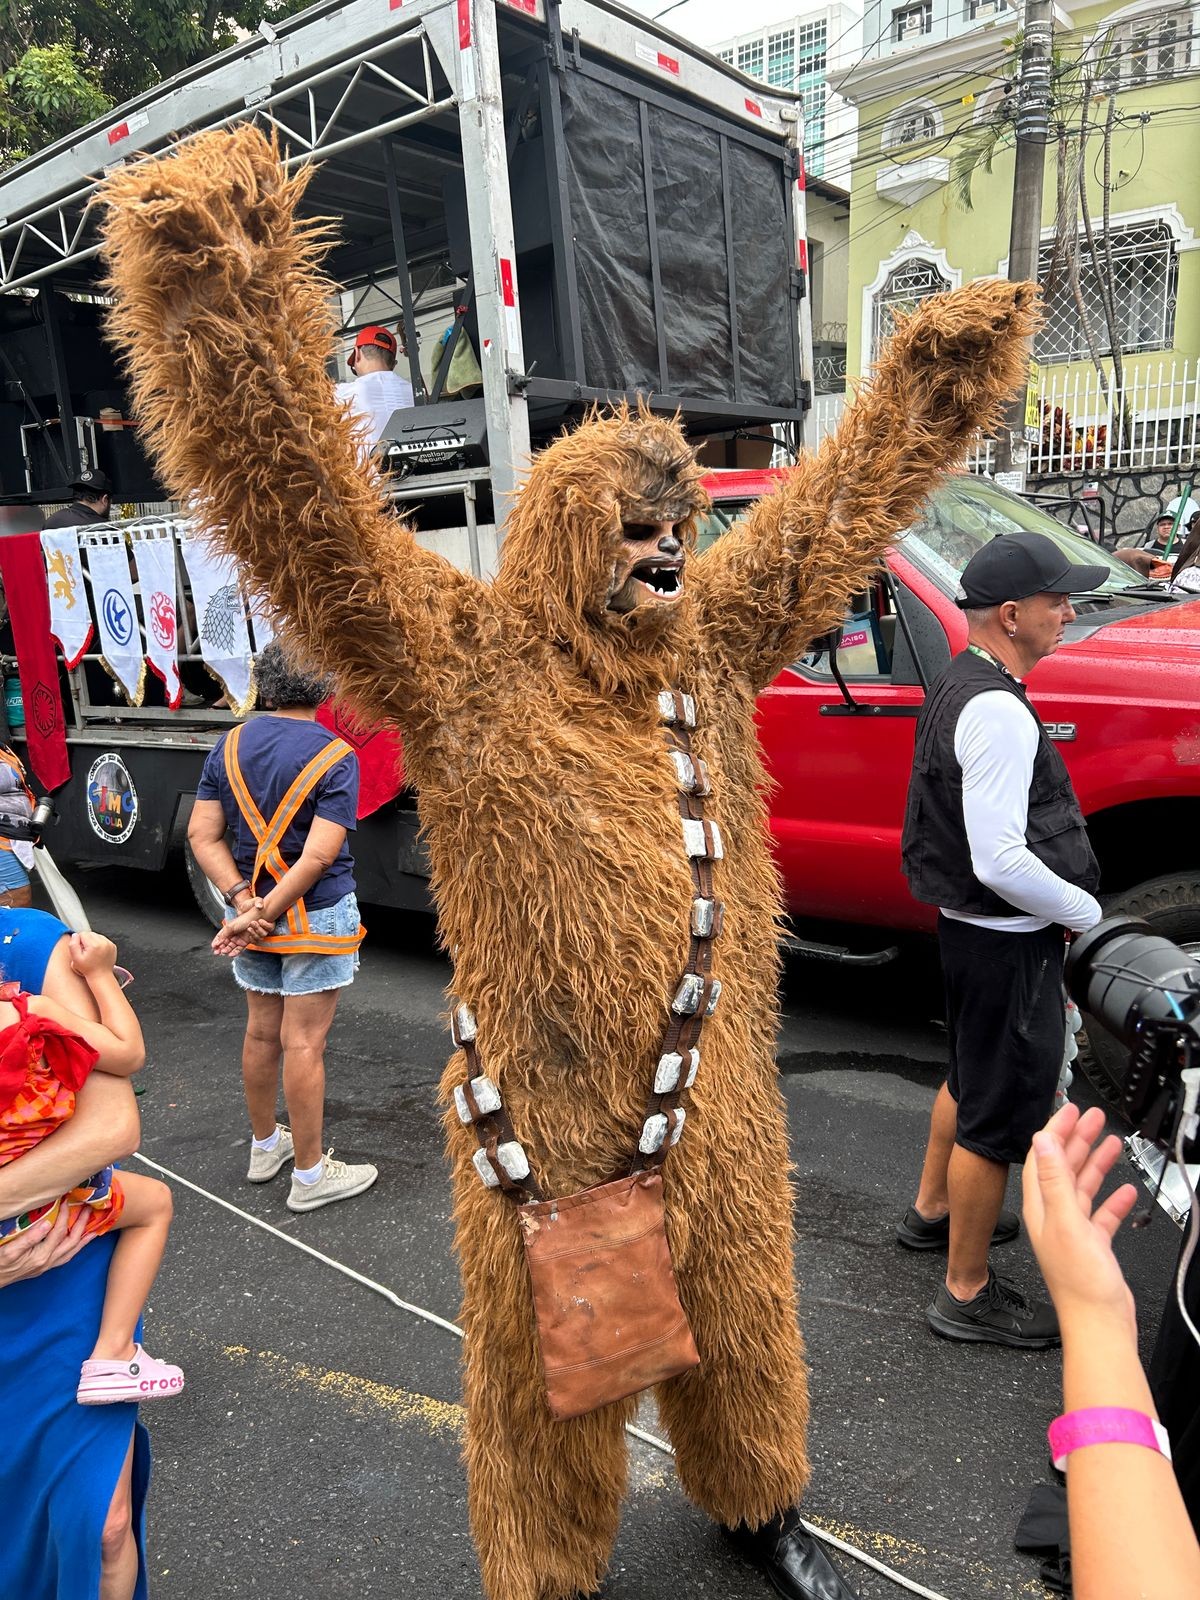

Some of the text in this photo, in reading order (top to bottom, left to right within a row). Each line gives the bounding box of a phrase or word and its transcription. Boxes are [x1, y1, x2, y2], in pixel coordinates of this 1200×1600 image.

[89, 781, 136, 815] CJMG
[99, 815, 123, 828] FOLIA
[140, 1377, 184, 1391] crocs
